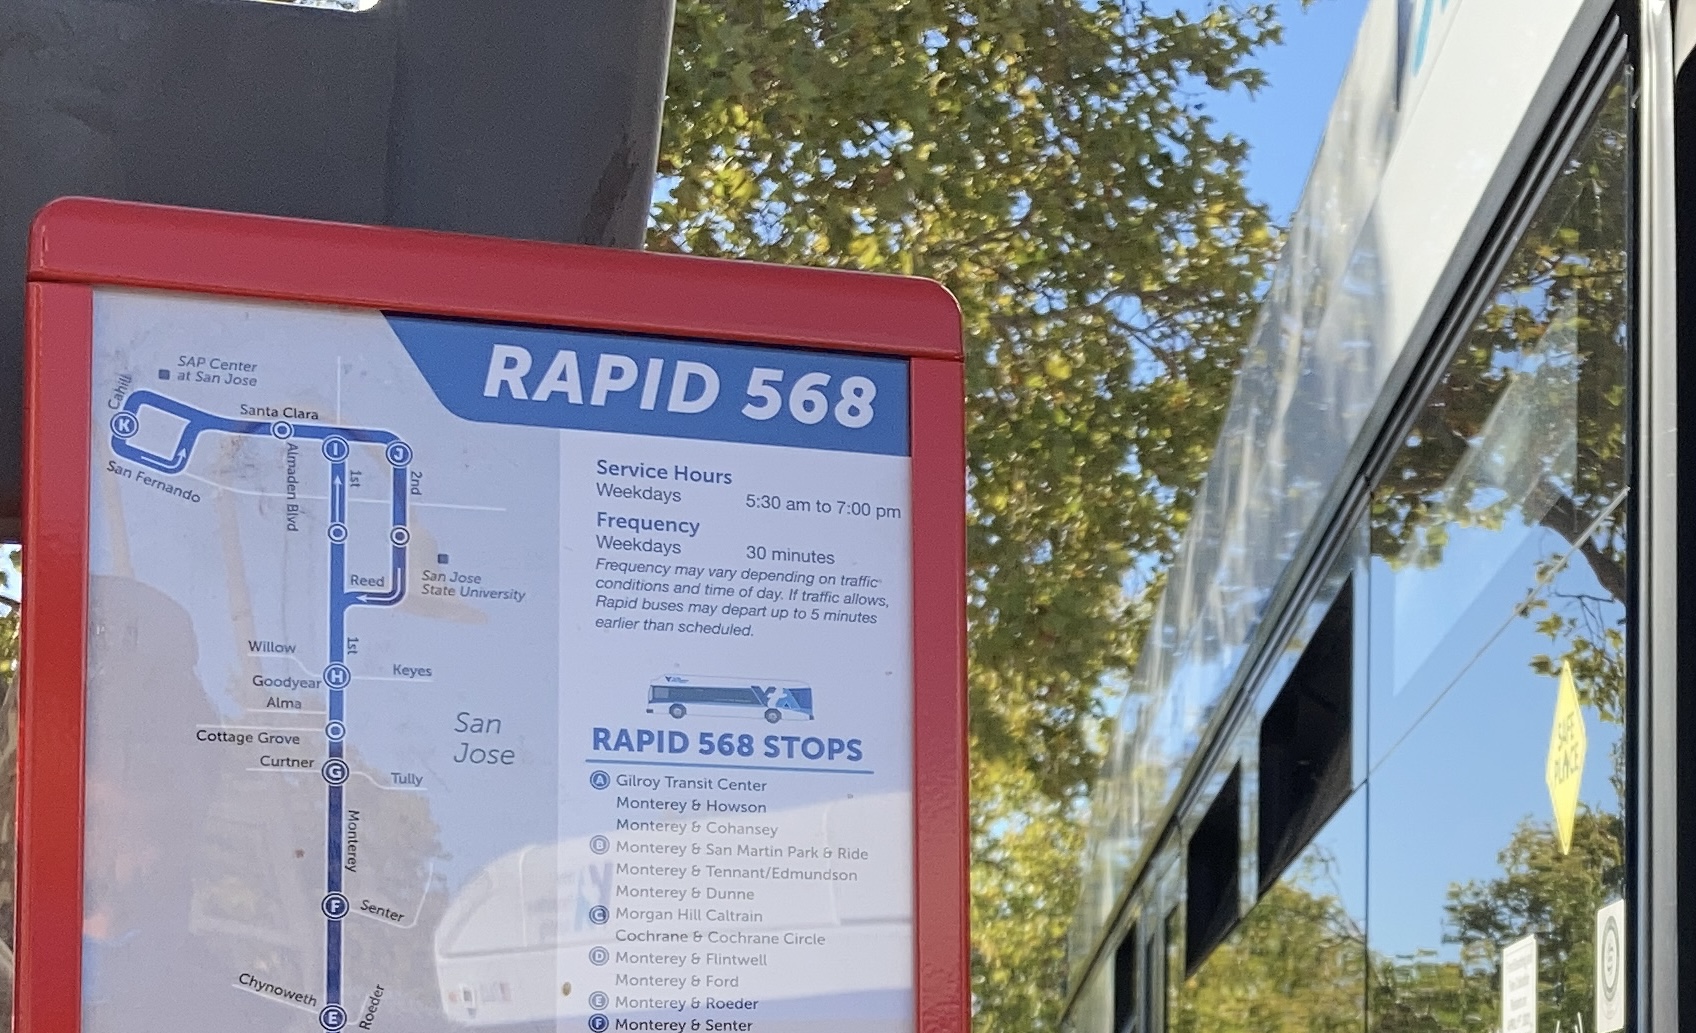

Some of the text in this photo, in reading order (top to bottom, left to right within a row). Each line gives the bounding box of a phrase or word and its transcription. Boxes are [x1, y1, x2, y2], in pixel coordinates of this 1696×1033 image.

[178, 355, 257, 372] SAP Center
[177, 369, 258, 387] at San Jose
[483, 343, 877, 429] RAPID 568
[108, 374, 132, 410] Cahill
[240, 404, 319, 421] Santa Clara
[117, 418, 131, 432] K
[349, 469, 361, 488] 1st
[596, 459, 733, 485] Service Hours
[106, 460, 201, 504] San Fernando
[286, 442, 300, 532] Almaden Blvd
[410, 471, 422, 496] 2nd
[596, 482, 902, 520] Weekdays 5:30 am to 7:00 pm
[597, 512, 700, 537] Frequency
[596, 535, 836, 565] Weekdays 30 minutes
[350, 574, 385, 588] Reed
[422, 570, 482, 584] San Jose
[422, 583, 526, 603] State University
[595, 616, 754, 637] earlier than scheduled.
[248, 640, 296, 654] Willow
[347, 637, 358, 655] 1st
[392, 664, 432, 680] Keyes
[252, 675, 322, 691] Goodyear
[266, 697, 302, 709] Alma
[454, 712, 502, 735] San
[196, 729, 300, 745] Cottage Grove
[592, 727, 863, 762] RAPID 568 STOPS
[260, 755, 315, 769] Curtner
[454, 742, 516, 765] Jose
[391, 771, 423, 787] Tully
[616, 774, 767, 792] Gilroy Transit Center
[345, 809, 360, 873] Monterey
[616, 863, 858, 882] Monterey & Tennant/Edmundson
[360, 899, 405, 923] Senter
[615, 930, 825, 946] Cochrane & Cochrane Circle
[238, 973, 317, 1007] Chynoweth
[359, 983, 386, 1031] Roeder
